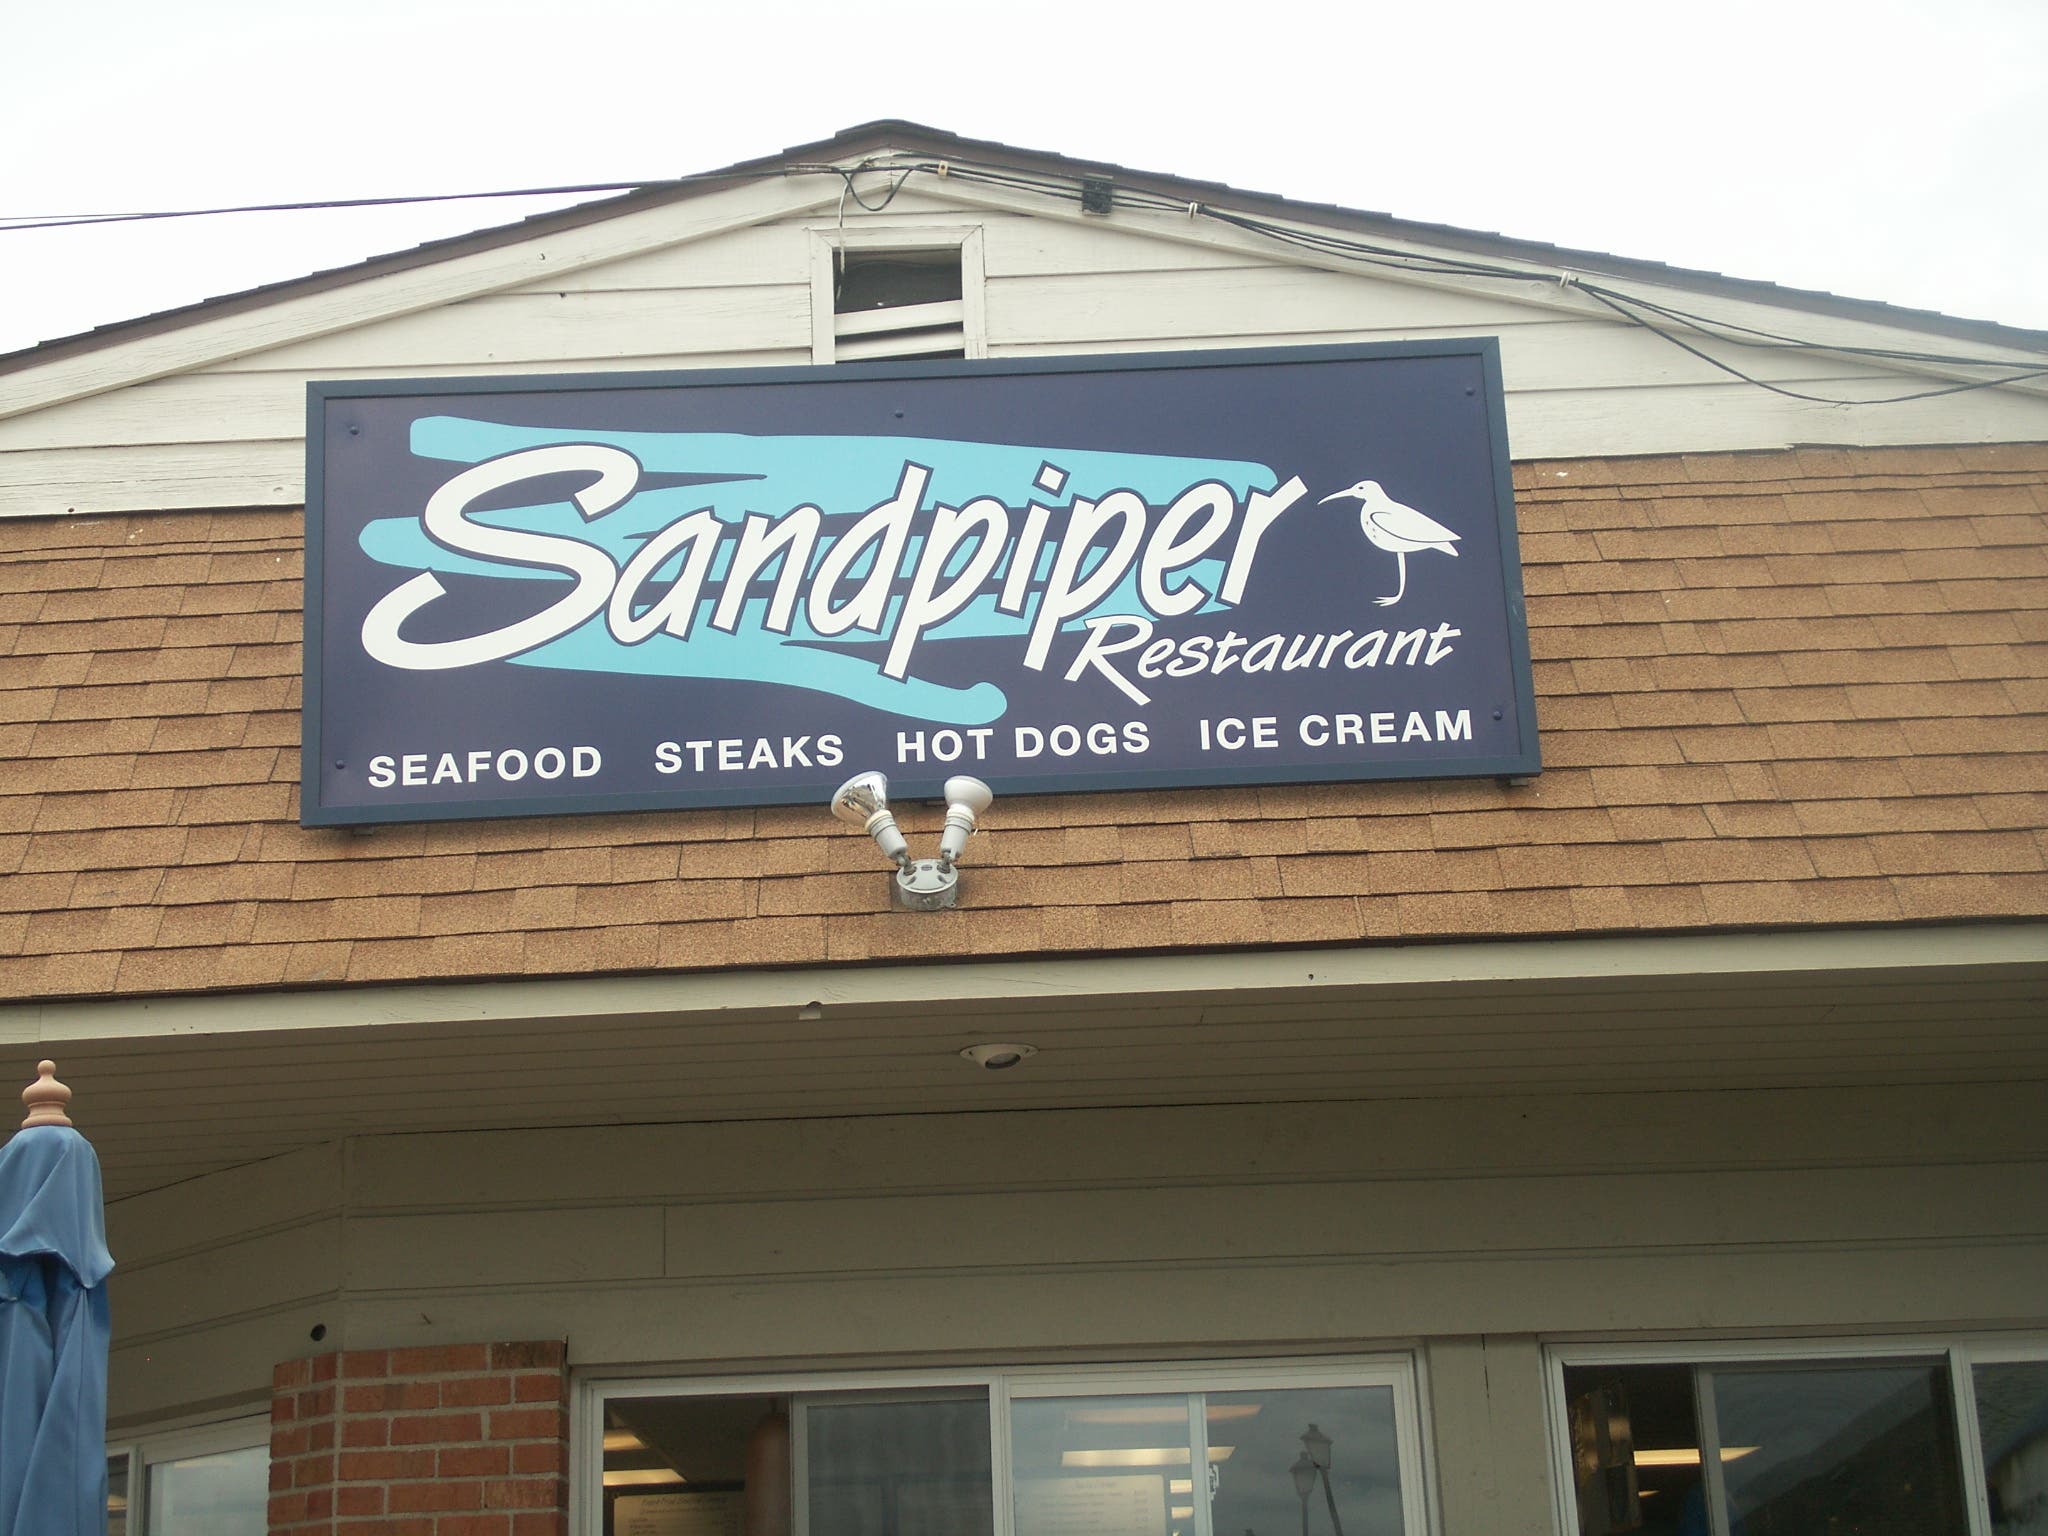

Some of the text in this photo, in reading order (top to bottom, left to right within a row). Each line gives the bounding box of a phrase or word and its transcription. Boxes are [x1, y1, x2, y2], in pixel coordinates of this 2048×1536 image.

[362, 446, 1307, 684] Sandpiper
[1064, 616, 1461, 705] Restaurant
[369, 710, 1471, 787] SEAFOOD STEAKS HOT DOGS ICE CREAM
